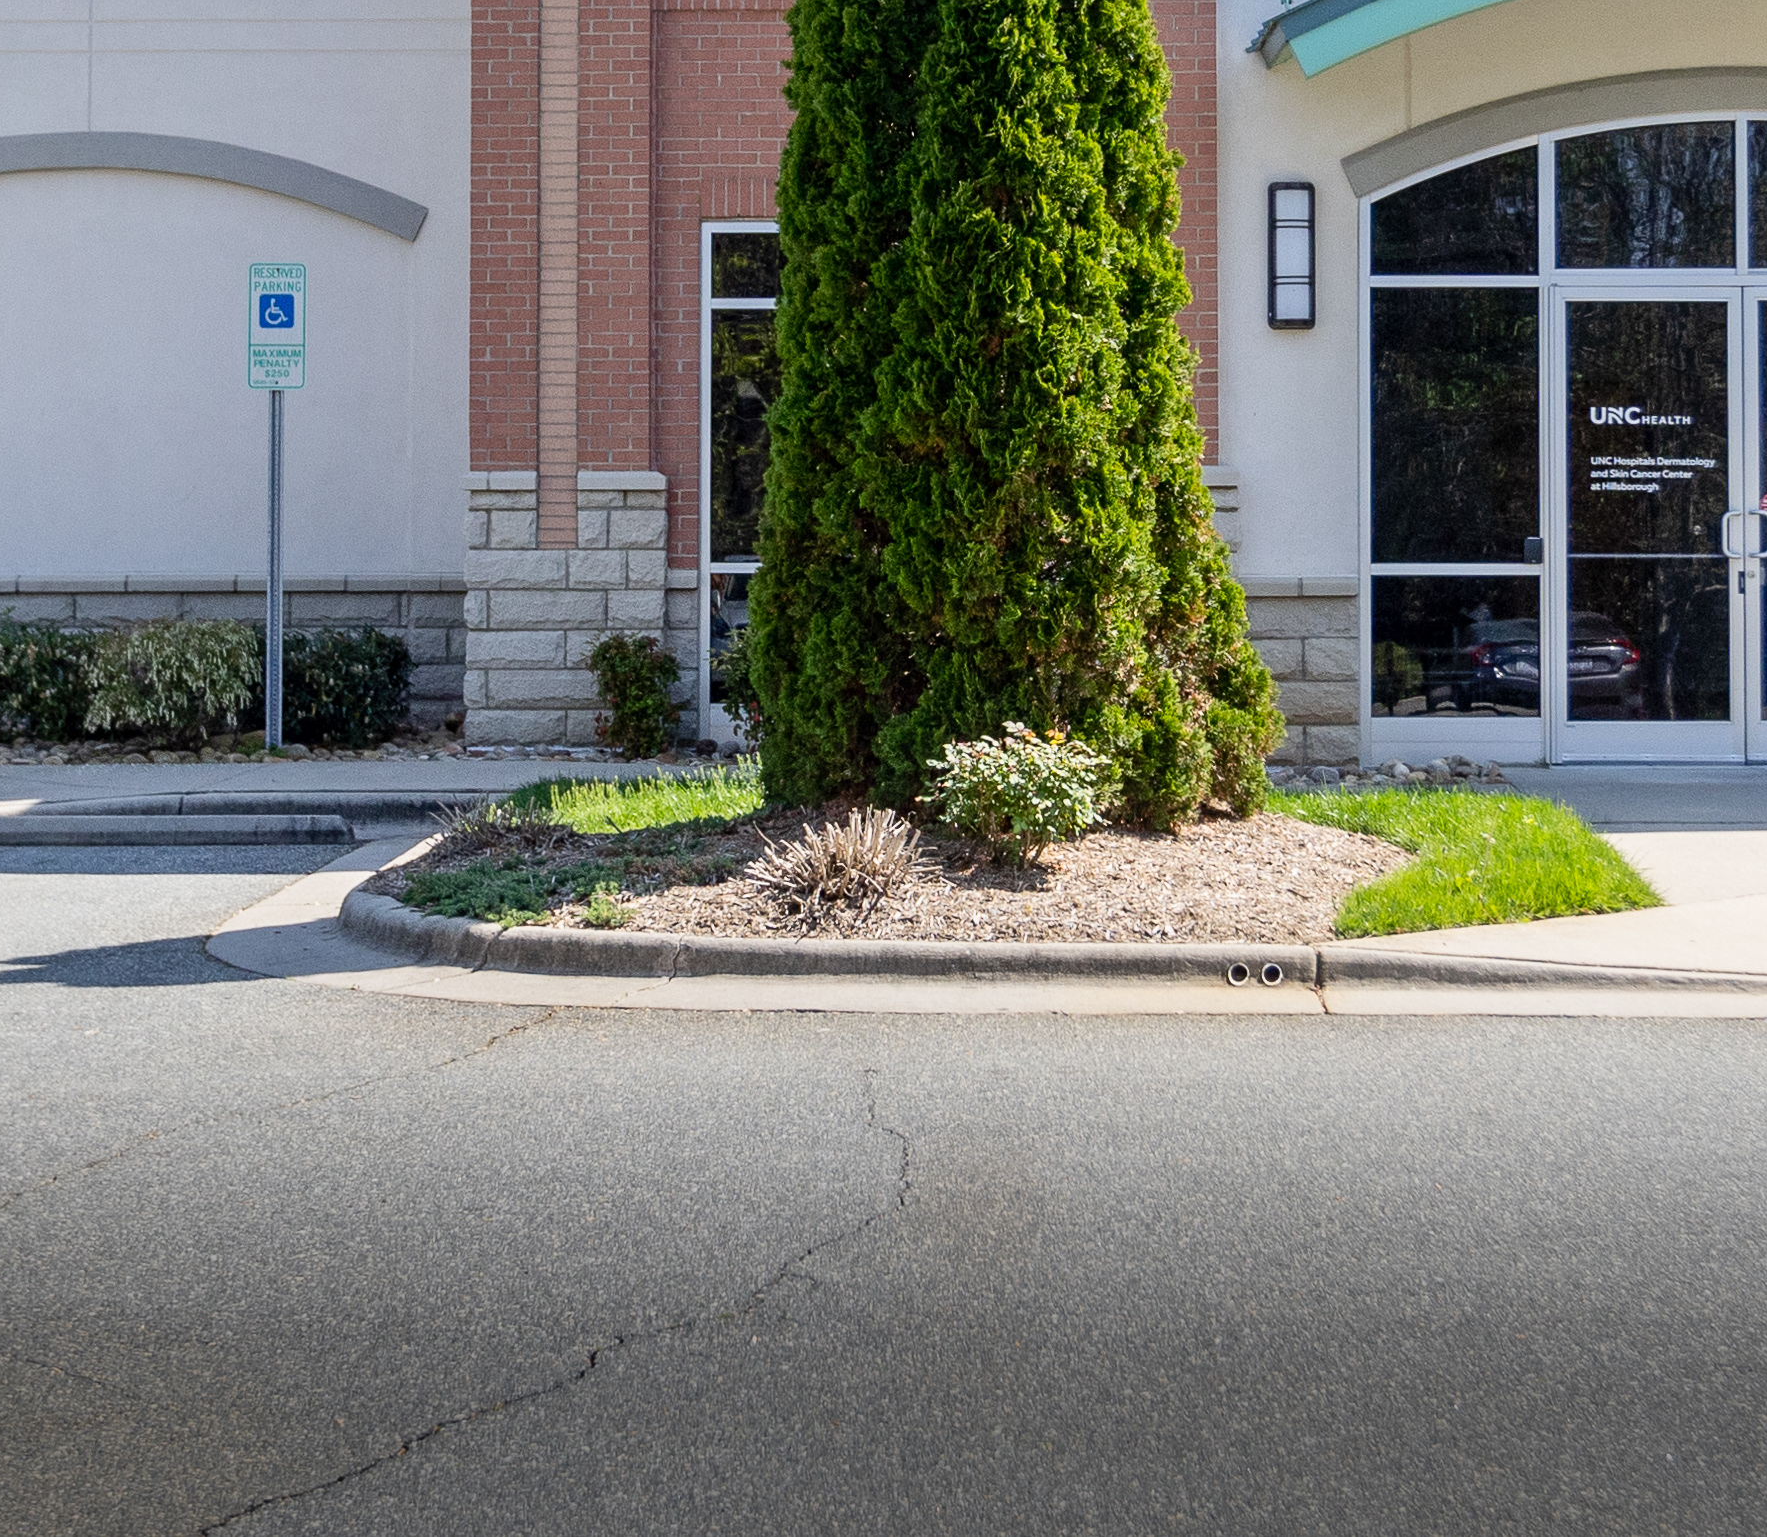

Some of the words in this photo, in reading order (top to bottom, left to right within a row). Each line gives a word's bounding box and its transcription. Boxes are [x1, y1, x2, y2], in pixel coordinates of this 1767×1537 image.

[253, 266, 303, 279] RESERVED
[253, 280, 303, 293] PARKING
[252, 349, 302, 358] MAXIMUM
[253, 359, 300, 368] PENALTY
[264, 369, 290, 378] $250
[1589, 406, 1641, 425] UNC
[1641, 415, 1691, 425] HEALTH
[1590, 456, 1613, 466] UNC
[1613, 456, 1656, 467] Hospitals
[1656, 457, 1715, 468] Dermatology
[1590, 469, 1609, 479] and
[1609, 469, 1629, 479] Skin
[1630, 469, 1662, 479] Cancer
[1662, 469, 1694, 479] Center
[1590, 483, 1601, 491] at
[1602, 481, 1659, 493] Hillsborough
